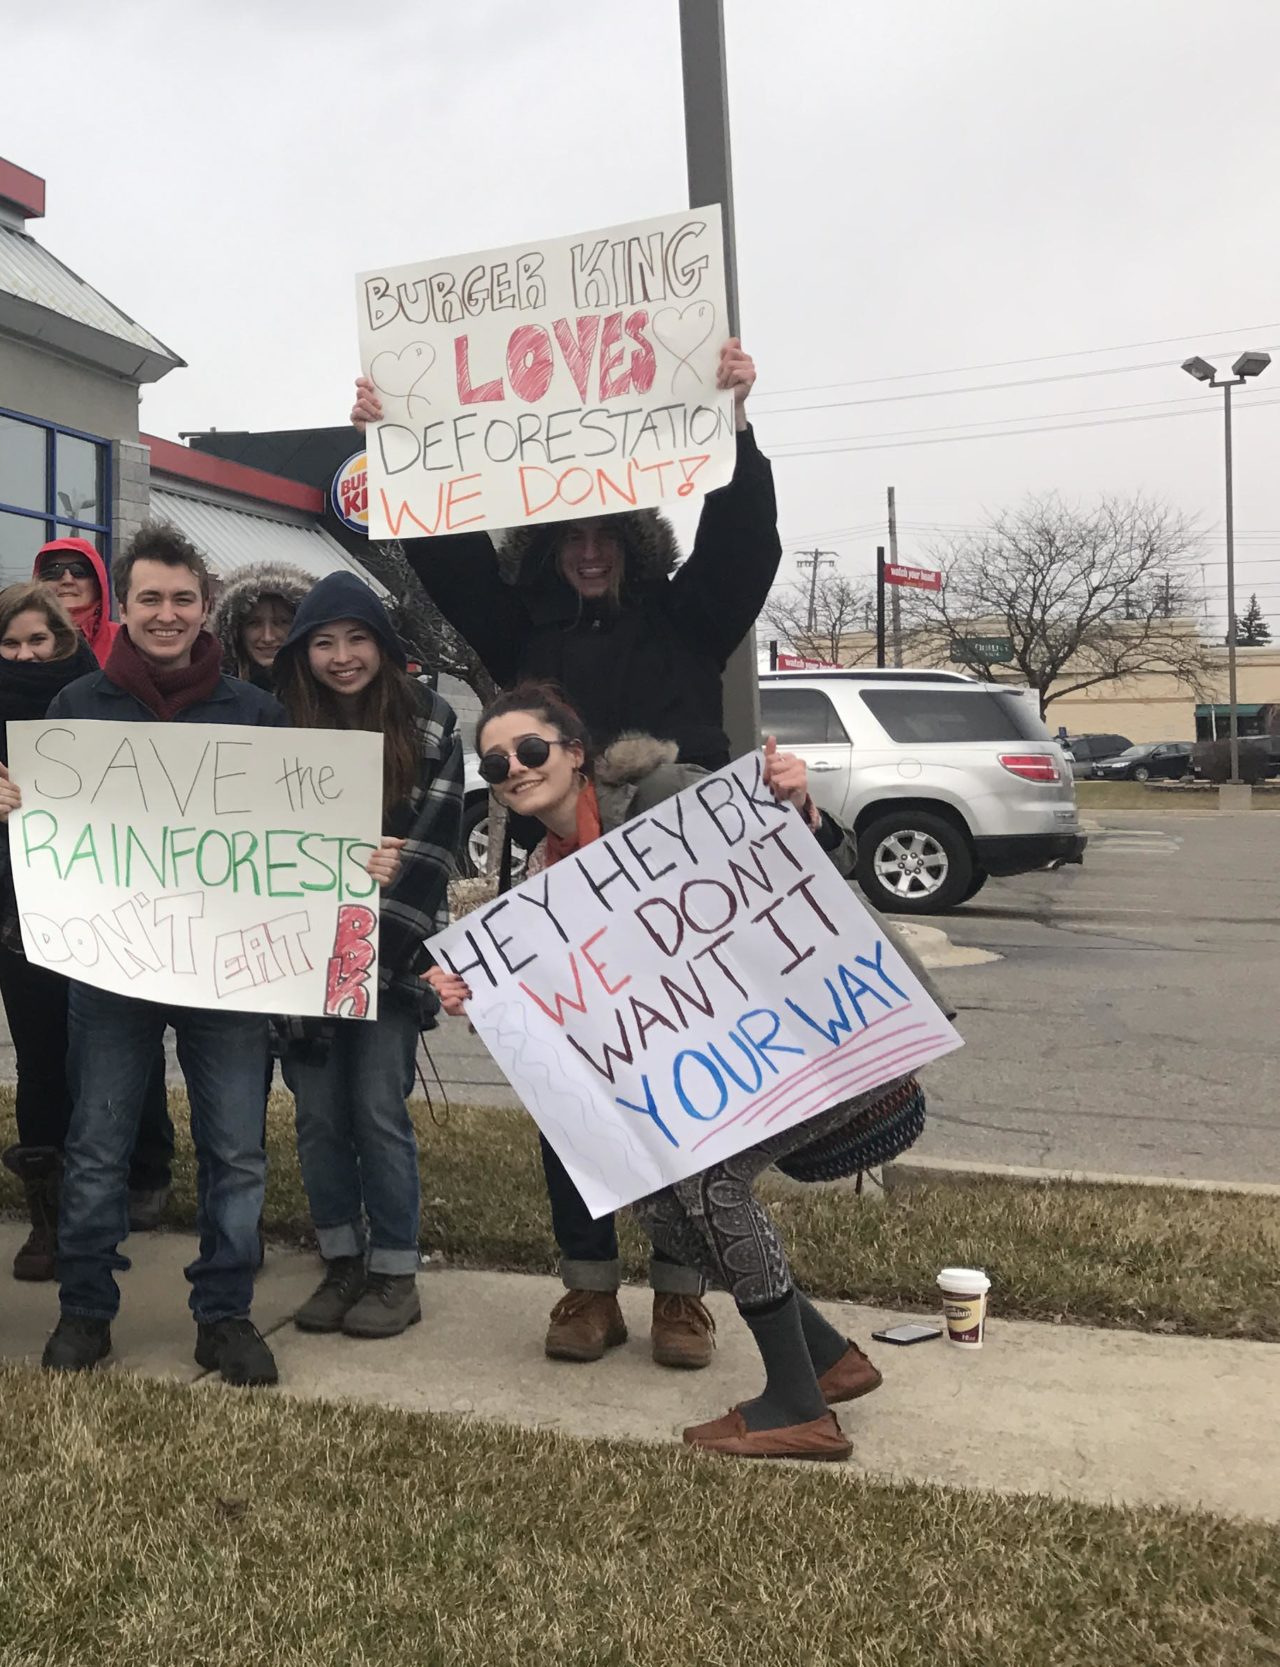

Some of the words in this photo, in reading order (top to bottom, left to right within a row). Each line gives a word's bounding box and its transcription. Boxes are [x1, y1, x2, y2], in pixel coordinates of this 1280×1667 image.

[364, 252, 546, 331] BURGER
[570, 221, 709, 309] KING
[454, 309, 658, 405] LOVES
[377, 400, 734, 475] DEFORESTATION
[380, 473, 486, 535] WE
[520, 455, 711, 517] DON'T!
[35, 728, 253, 816] SAVE
[275, 757, 344, 812] the
[22, 809, 378, 901] RAINFORESTS
[440, 874, 569, 986] HEY
[576, 796, 699, 911] HEY
[696, 757, 790, 847] BK
[23, 891, 205, 980] DON'T
[214, 911, 314, 999] EAT
[519, 927, 632, 1026] WE
[634, 822, 806, 957] DON'T
[566, 931, 749, 1084] WANT
[752, 874, 839, 975] IT
[616, 1008, 806, 1147] YOUR
[785, 940, 911, 1046] WAY
